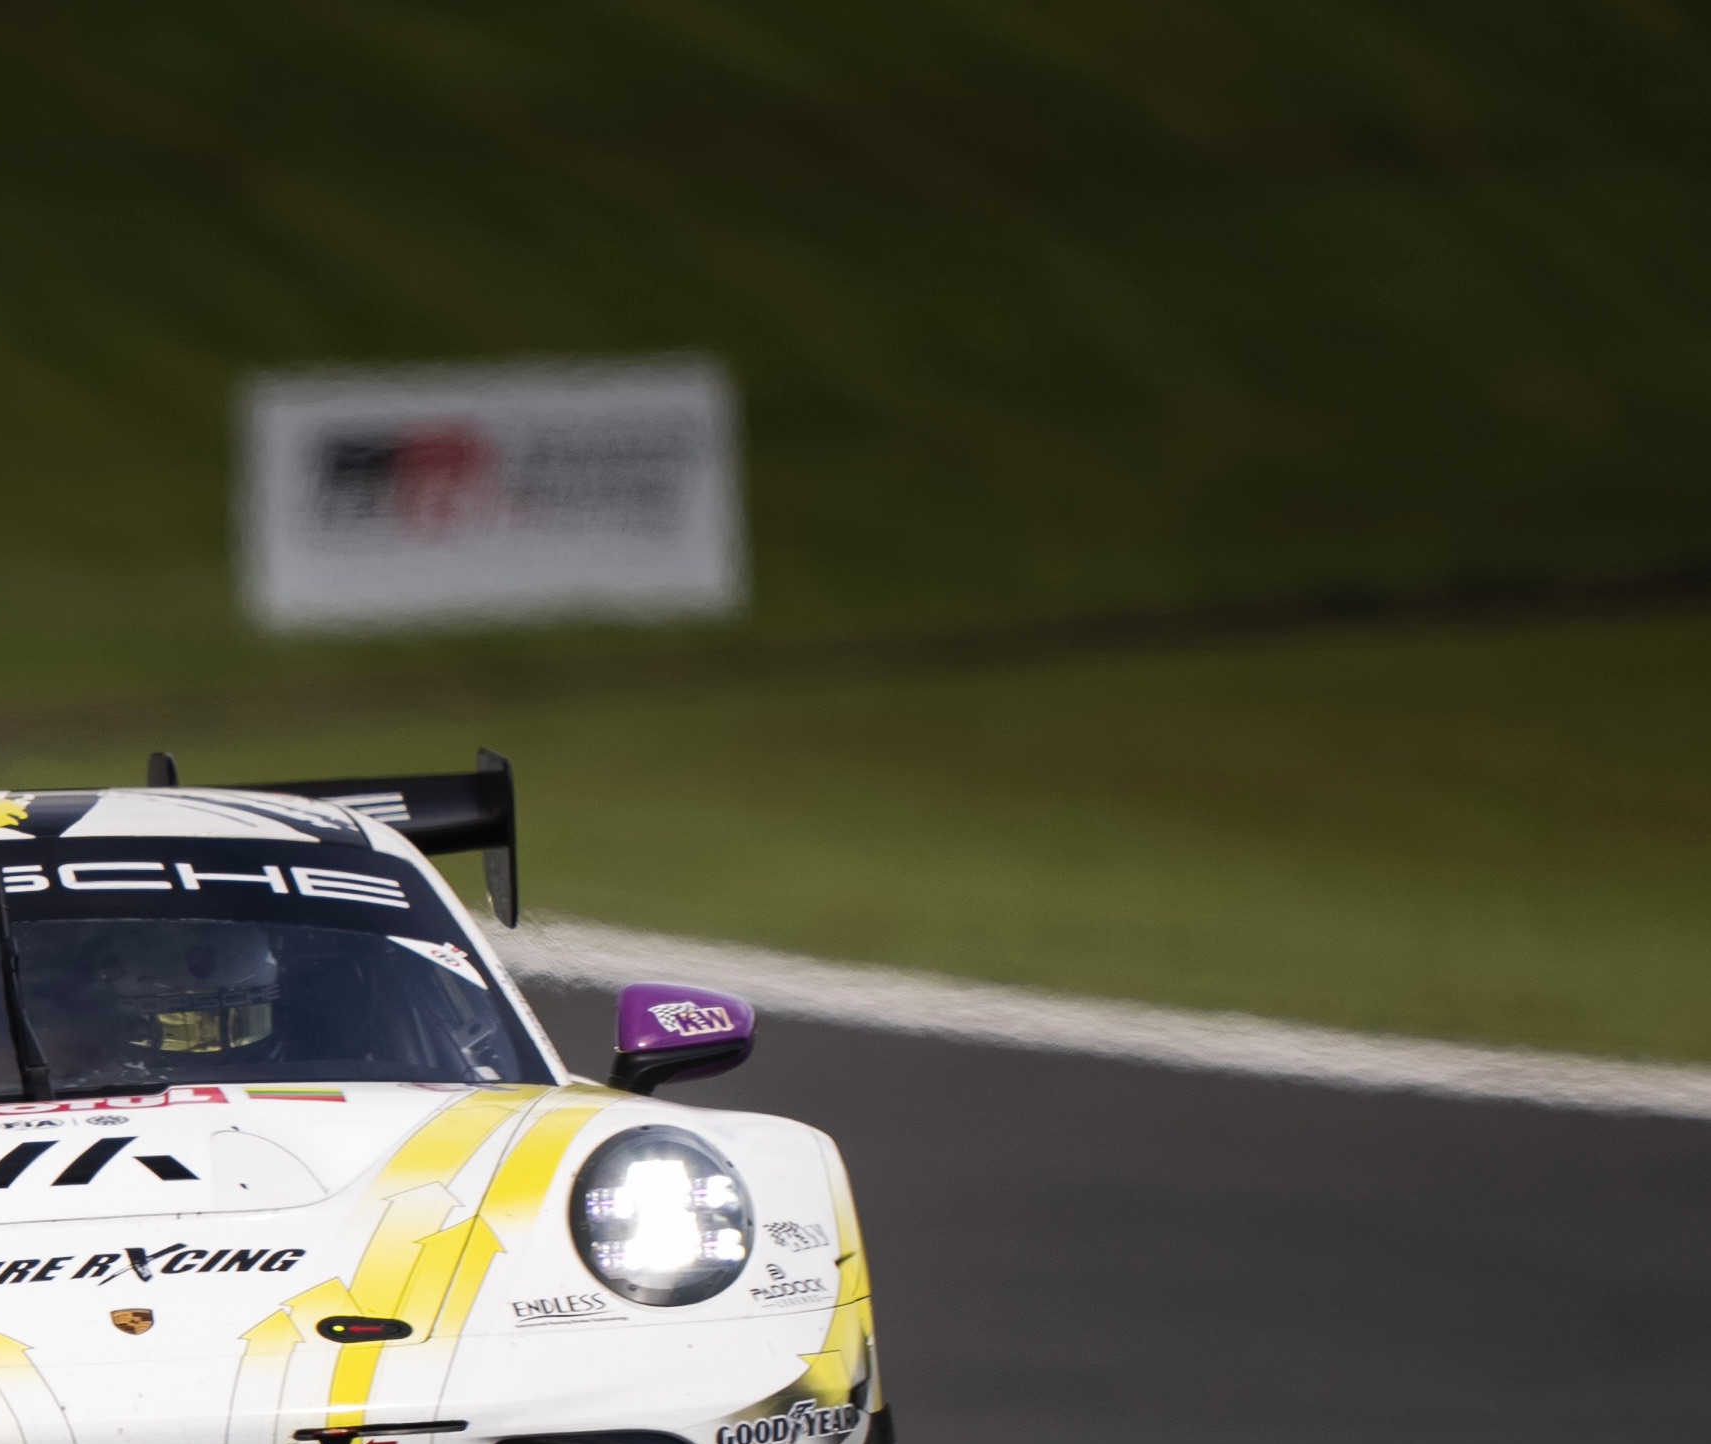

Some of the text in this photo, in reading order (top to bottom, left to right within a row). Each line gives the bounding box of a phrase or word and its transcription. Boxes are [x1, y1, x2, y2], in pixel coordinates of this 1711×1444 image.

[70, 1243, 307, 1284] RXCING
[749, 1278, 828, 1301] PADDOCK
[511, 1293, 606, 1317] ENDLESS
